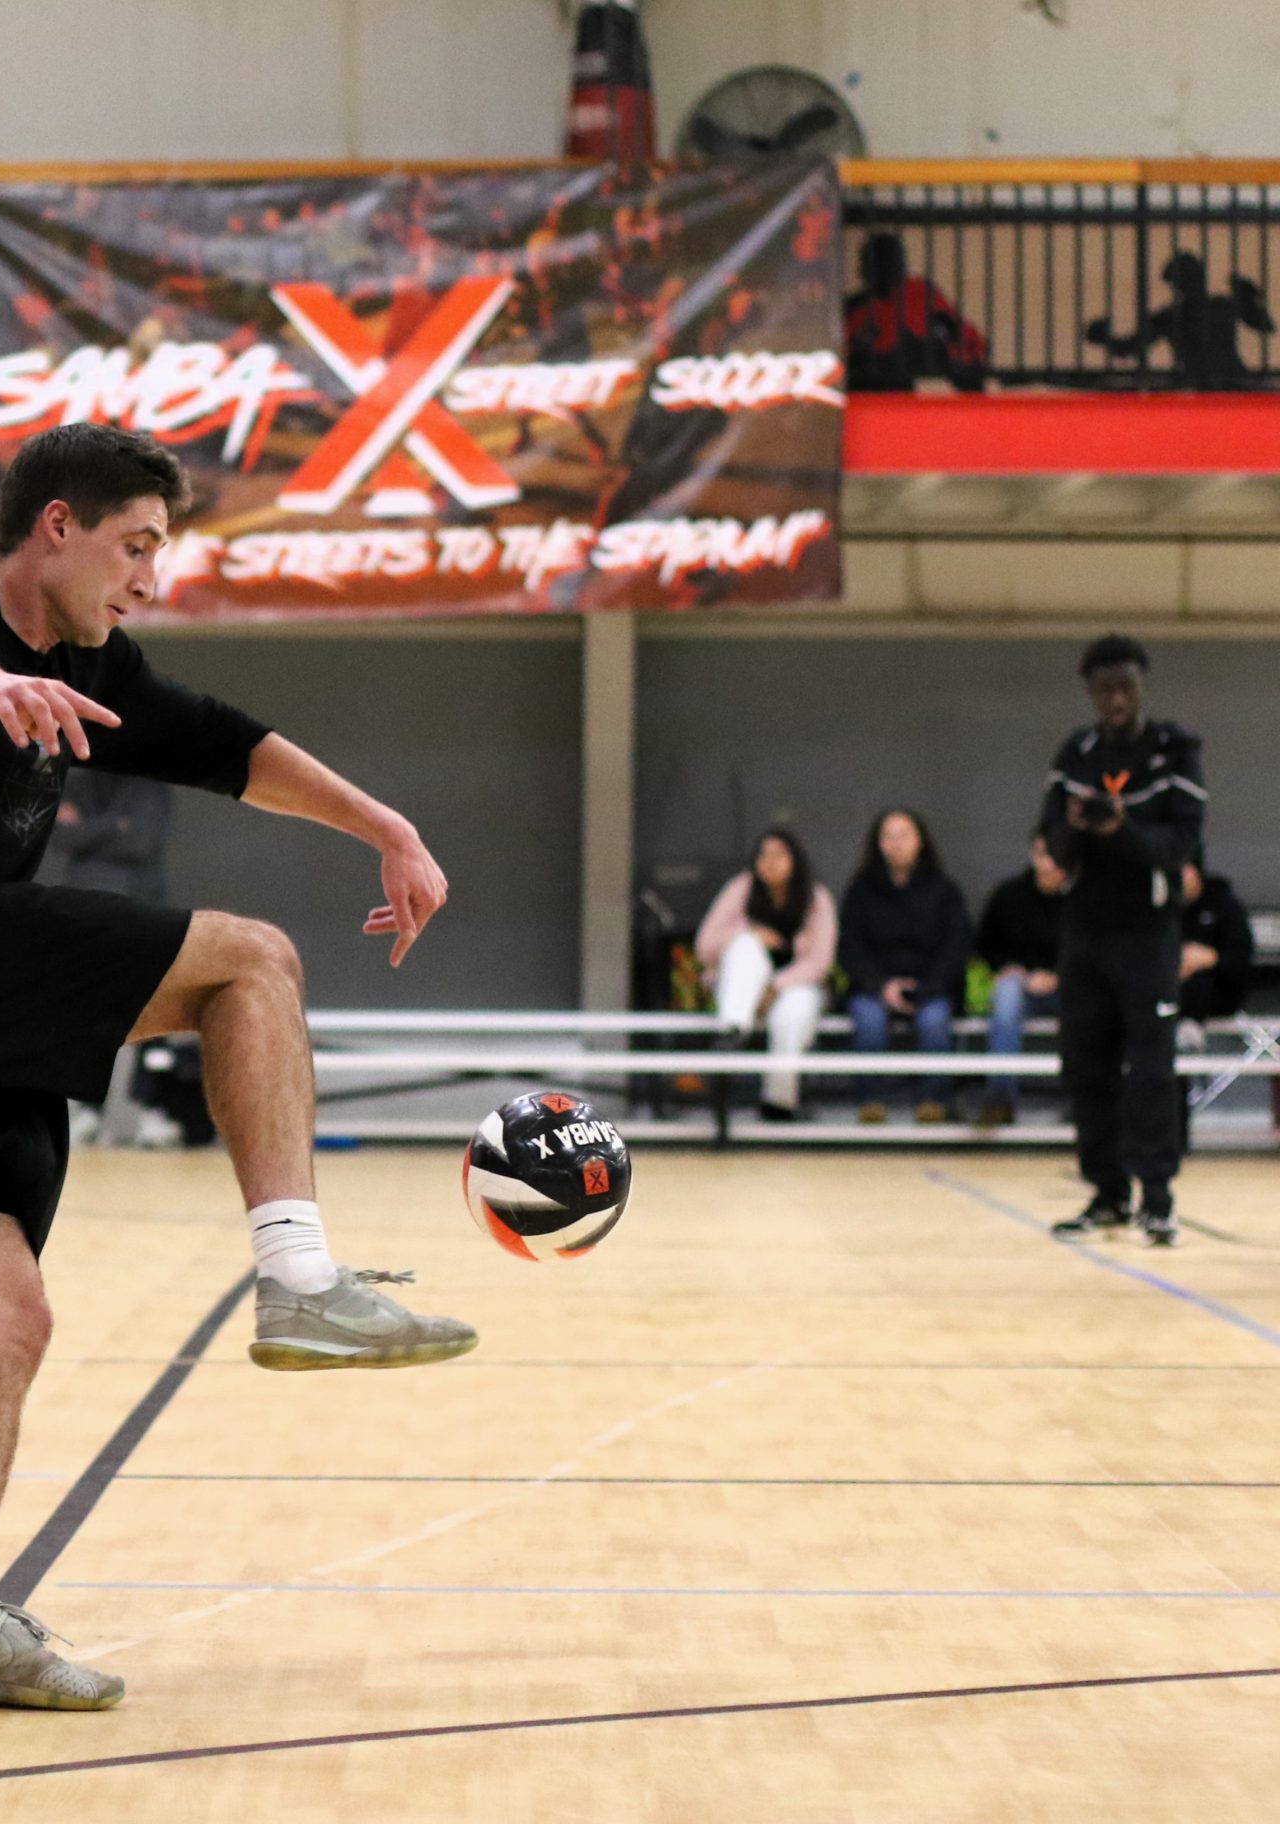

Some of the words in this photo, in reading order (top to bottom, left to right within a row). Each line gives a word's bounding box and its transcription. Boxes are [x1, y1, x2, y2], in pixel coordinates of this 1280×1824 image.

[269, 276, 523, 517] X
[436, 526, 495, 574] TO
[530, 1133, 555, 1161] X
[552, 1120, 624, 1148] SAMBA
